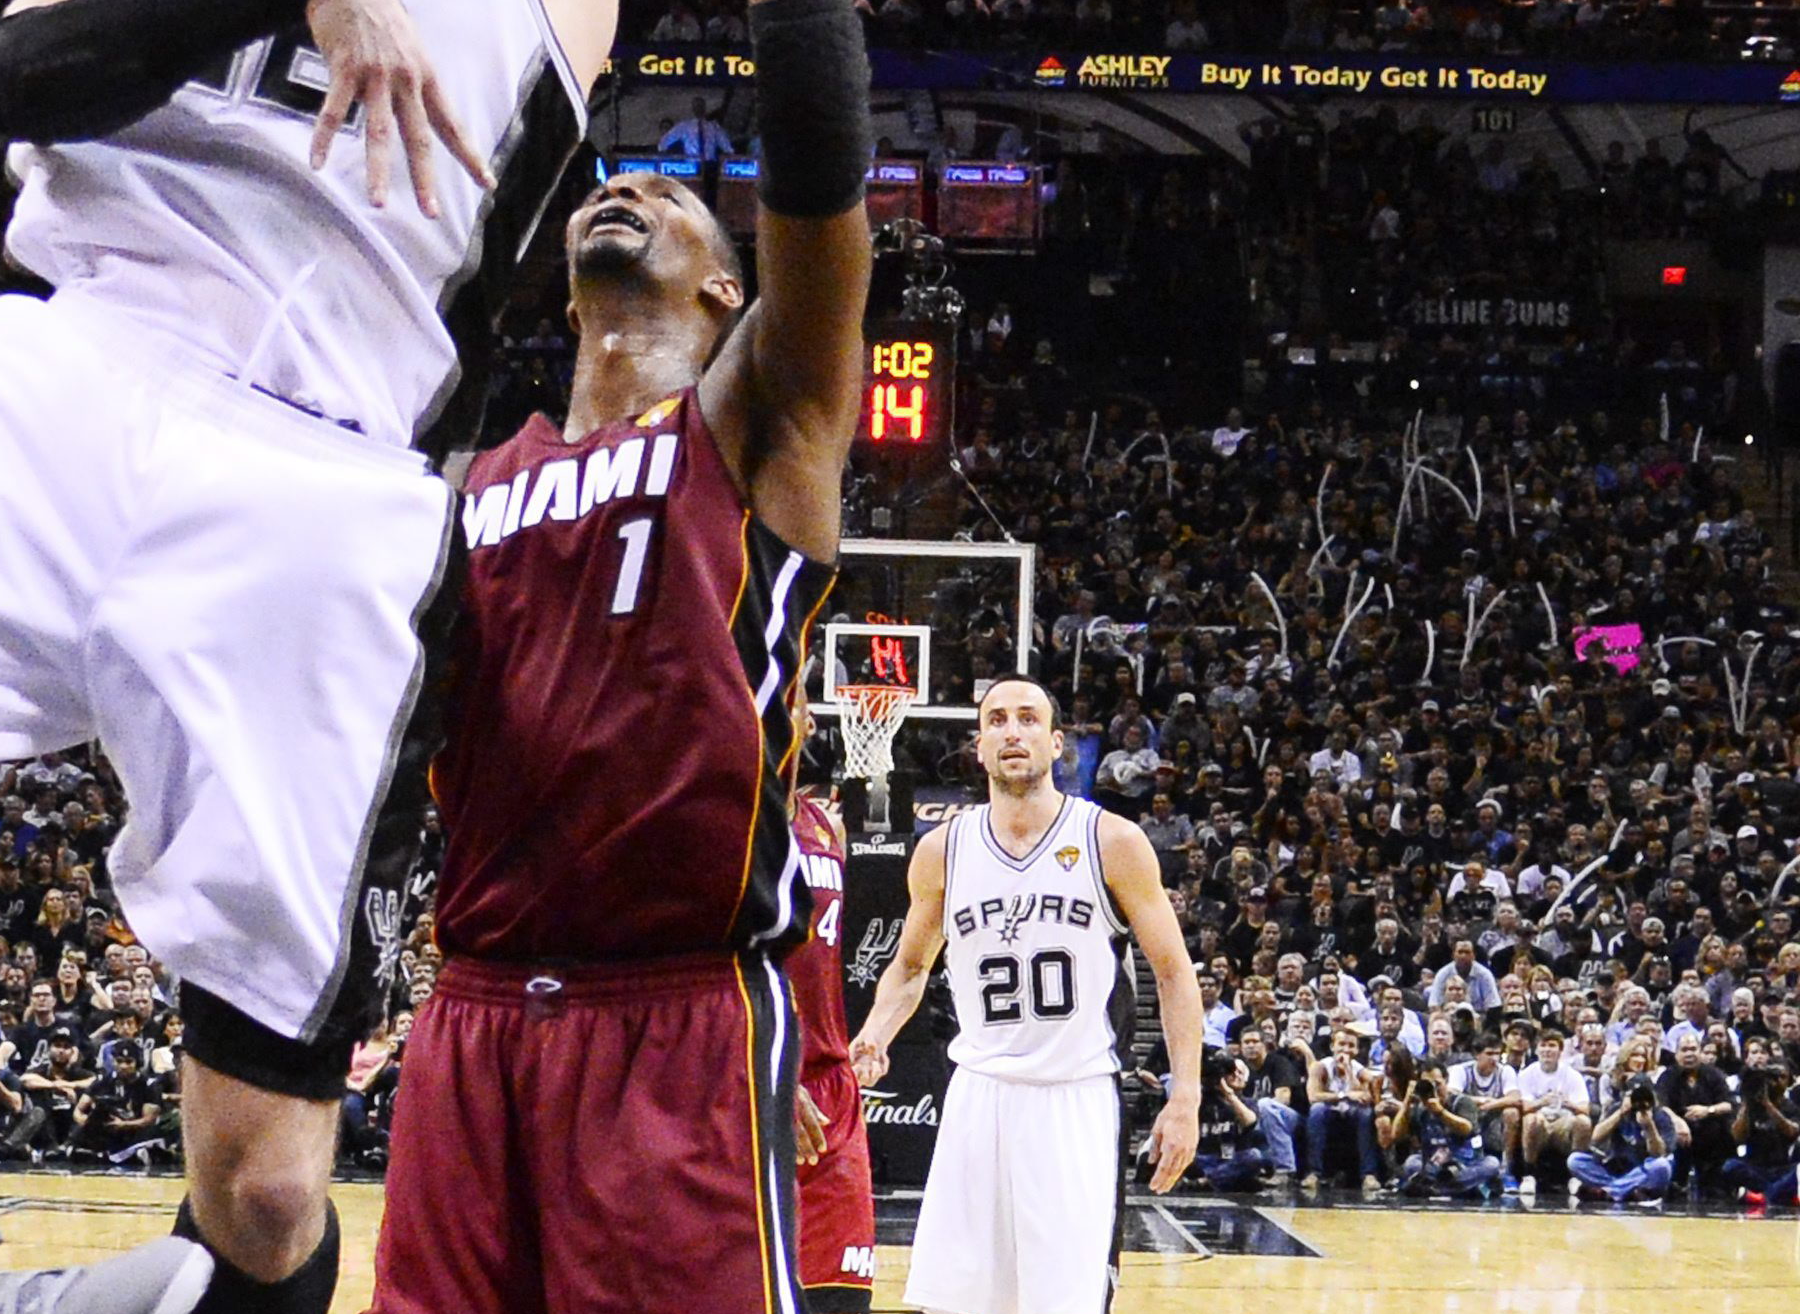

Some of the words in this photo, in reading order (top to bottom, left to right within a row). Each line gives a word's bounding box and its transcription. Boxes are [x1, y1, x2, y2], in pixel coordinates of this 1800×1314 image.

[638, 54, 686, 75] Get
[695, 55, 715, 76] It
[1077, 55, 1172, 77] ASHLEY
[1201, 63, 1251, 90] Buy
[1262, 64, 1281, 85] It
[1291, 65, 1371, 92] Today
[1380, 67, 1429, 88] Get
[1438, 68, 1458, 88] It
[1466, 68, 1546, 95] Today
[873, 341, 933, 379] 1:02
[871, 383, 923, 440] 14
[462, 433, 678, 550] MIAMI
[611, 518, 653, 615] 1
[851, 841, 906, 857] SPALDING
[817, 898, 840, 946] 4
[953, 893, 1094, 946] SPURS
[976, 946, 1079, 1027] 20
